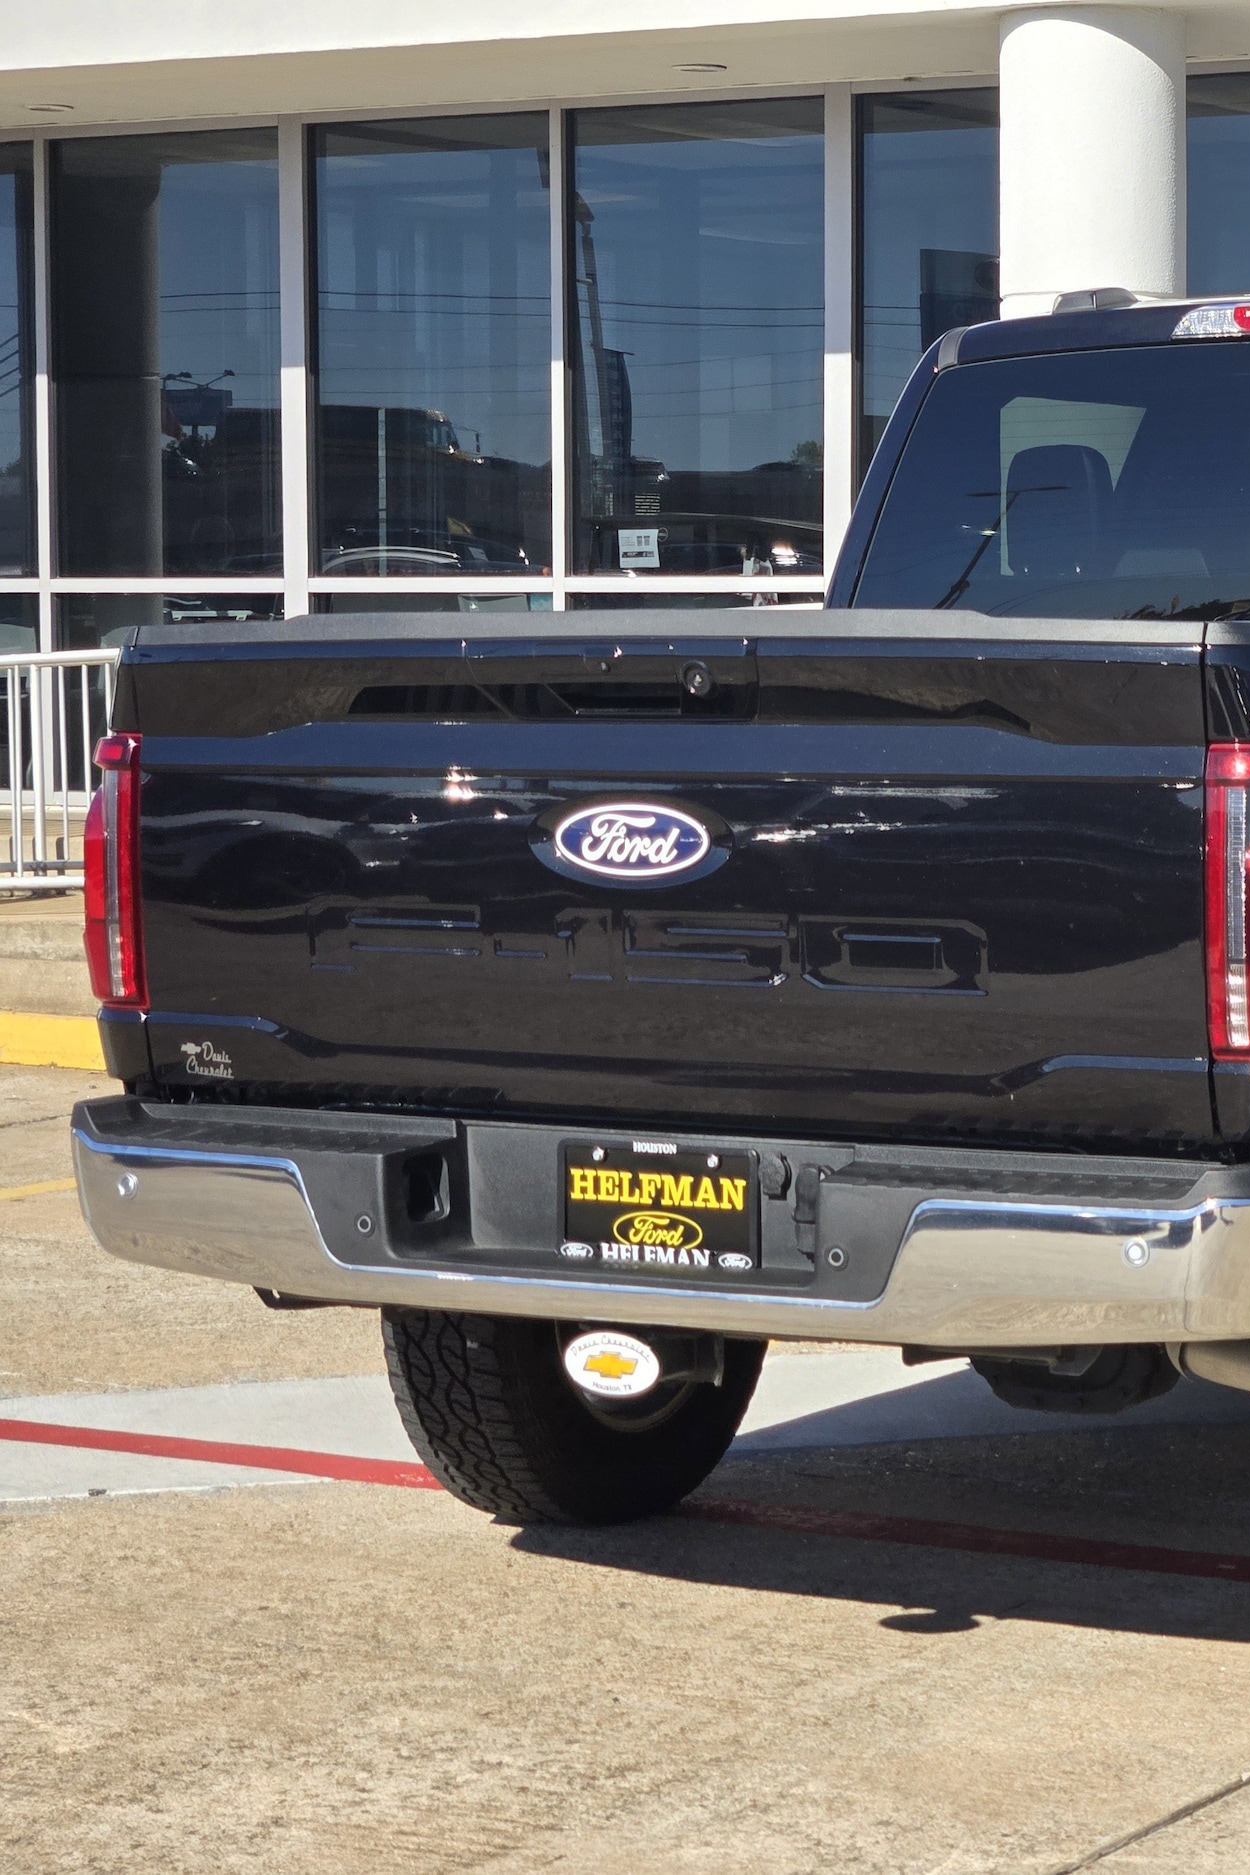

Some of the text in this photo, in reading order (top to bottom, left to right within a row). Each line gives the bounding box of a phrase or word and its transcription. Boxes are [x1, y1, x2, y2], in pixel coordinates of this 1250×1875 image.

[582, 813, 680, 864] Ford
[202, 1041, 232, 1063] Davis
[186, 1055, 234, 1079] Chevrolet
[632, 1140, 677, 1155] HOUSTON
[569, 1167, 747, 1211] HELFMAN
[628, 1215, 685, 1247] Ford
